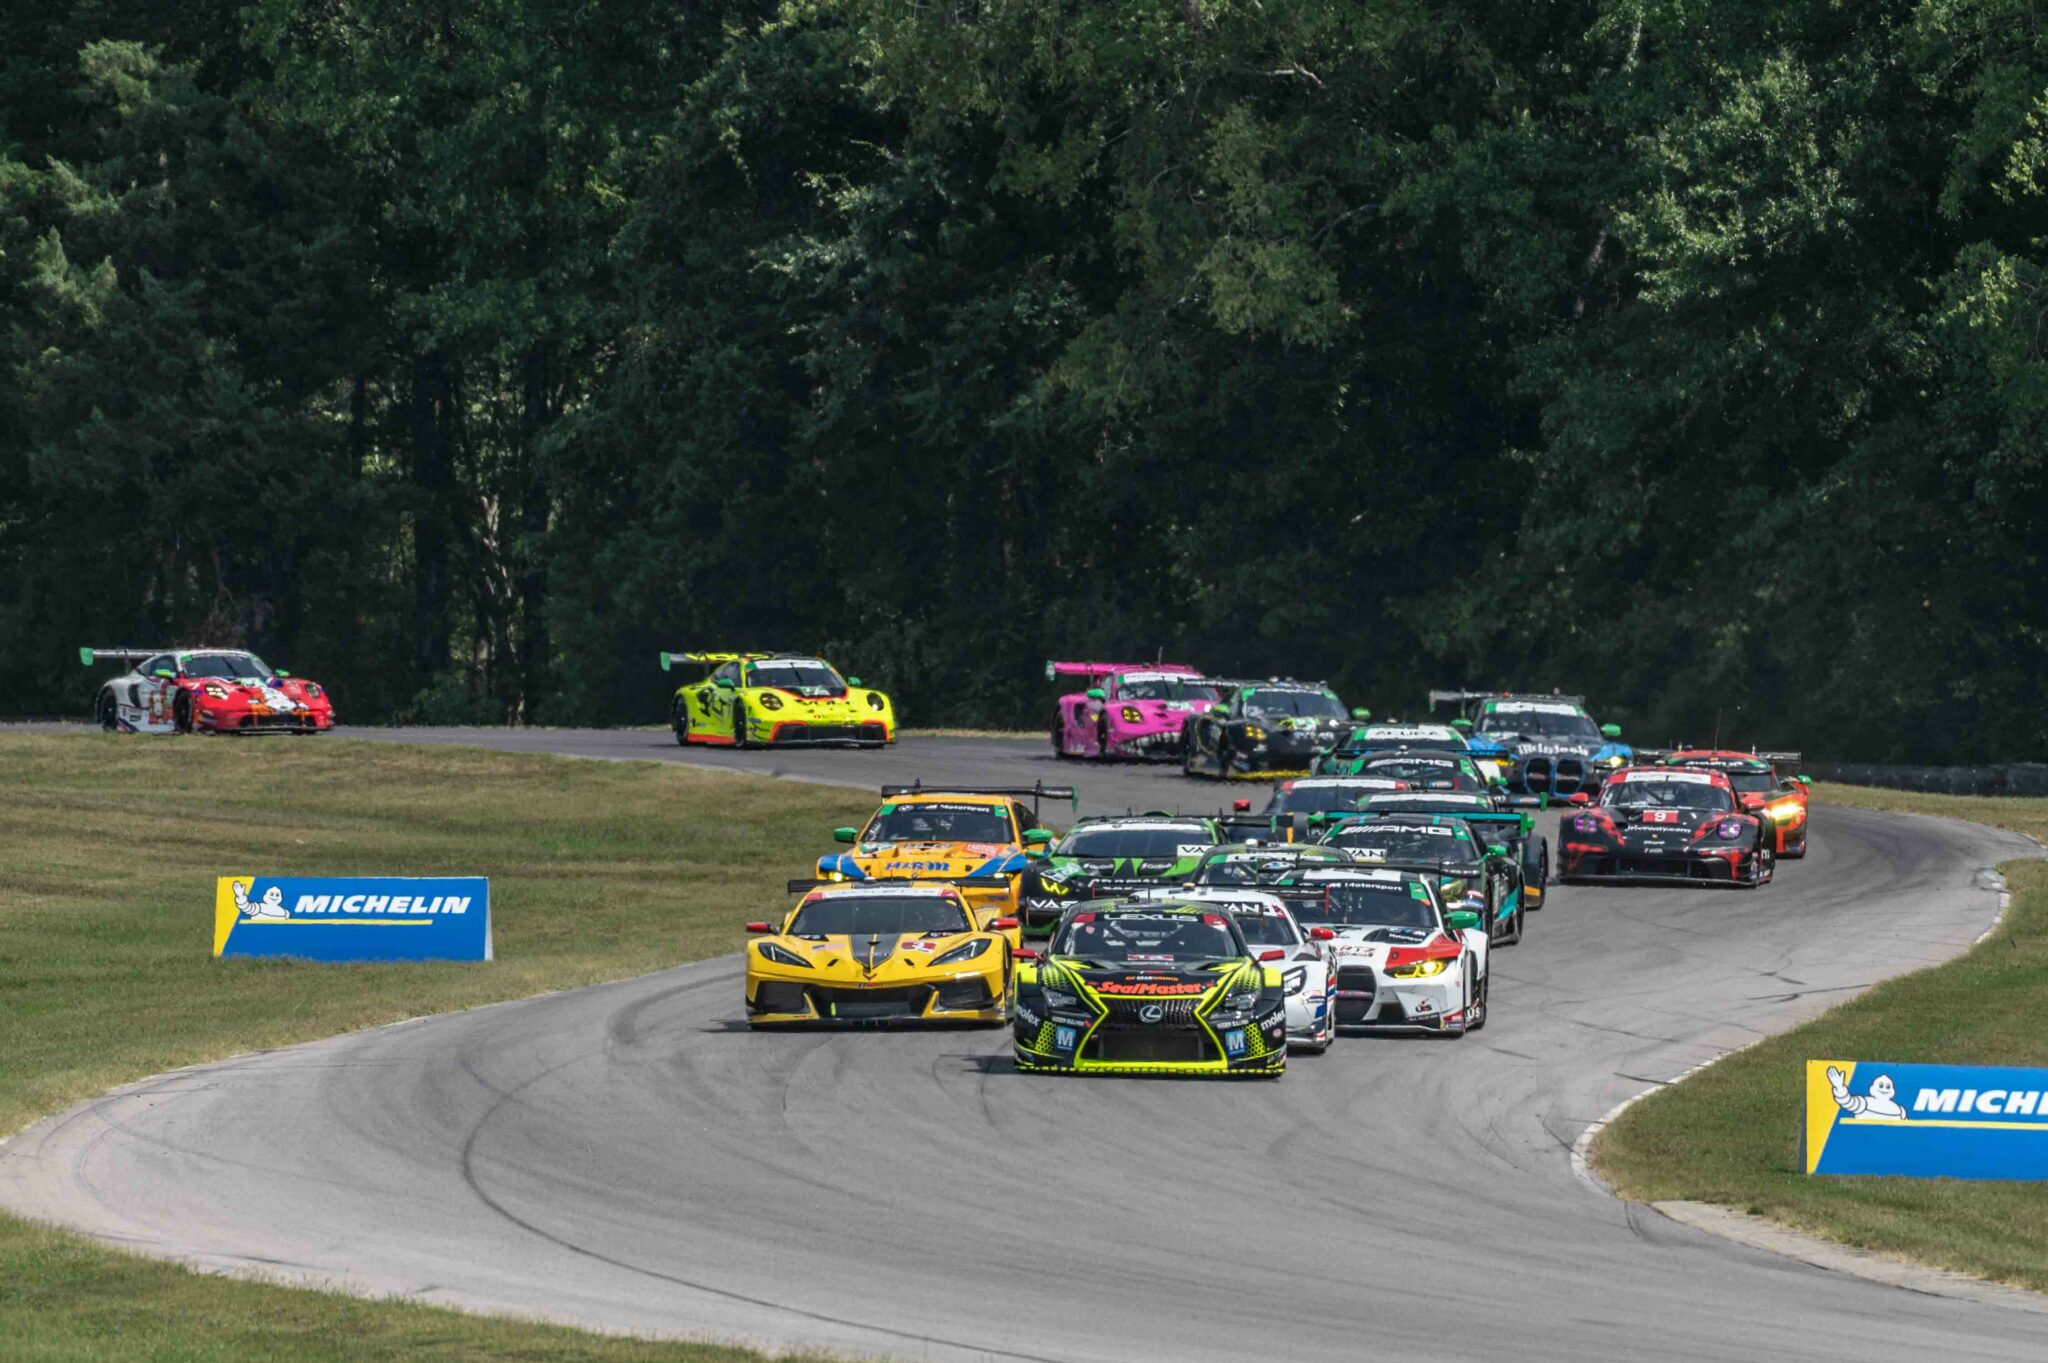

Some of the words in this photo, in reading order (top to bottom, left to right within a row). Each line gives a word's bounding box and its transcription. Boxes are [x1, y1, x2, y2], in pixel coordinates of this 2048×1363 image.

[1654, 812, 1666, 822] 9
[1344, 882, 1404, 892] Motorsport
[294, 894, 472, 915] MICHELIN
[1103, 913, 1199, 923] LEXUS
[1097, 981, 1201, 994] SealMaster
[1057, 1029, 1074, 1047] M
[1227, 1030, 1245, 1051] M
